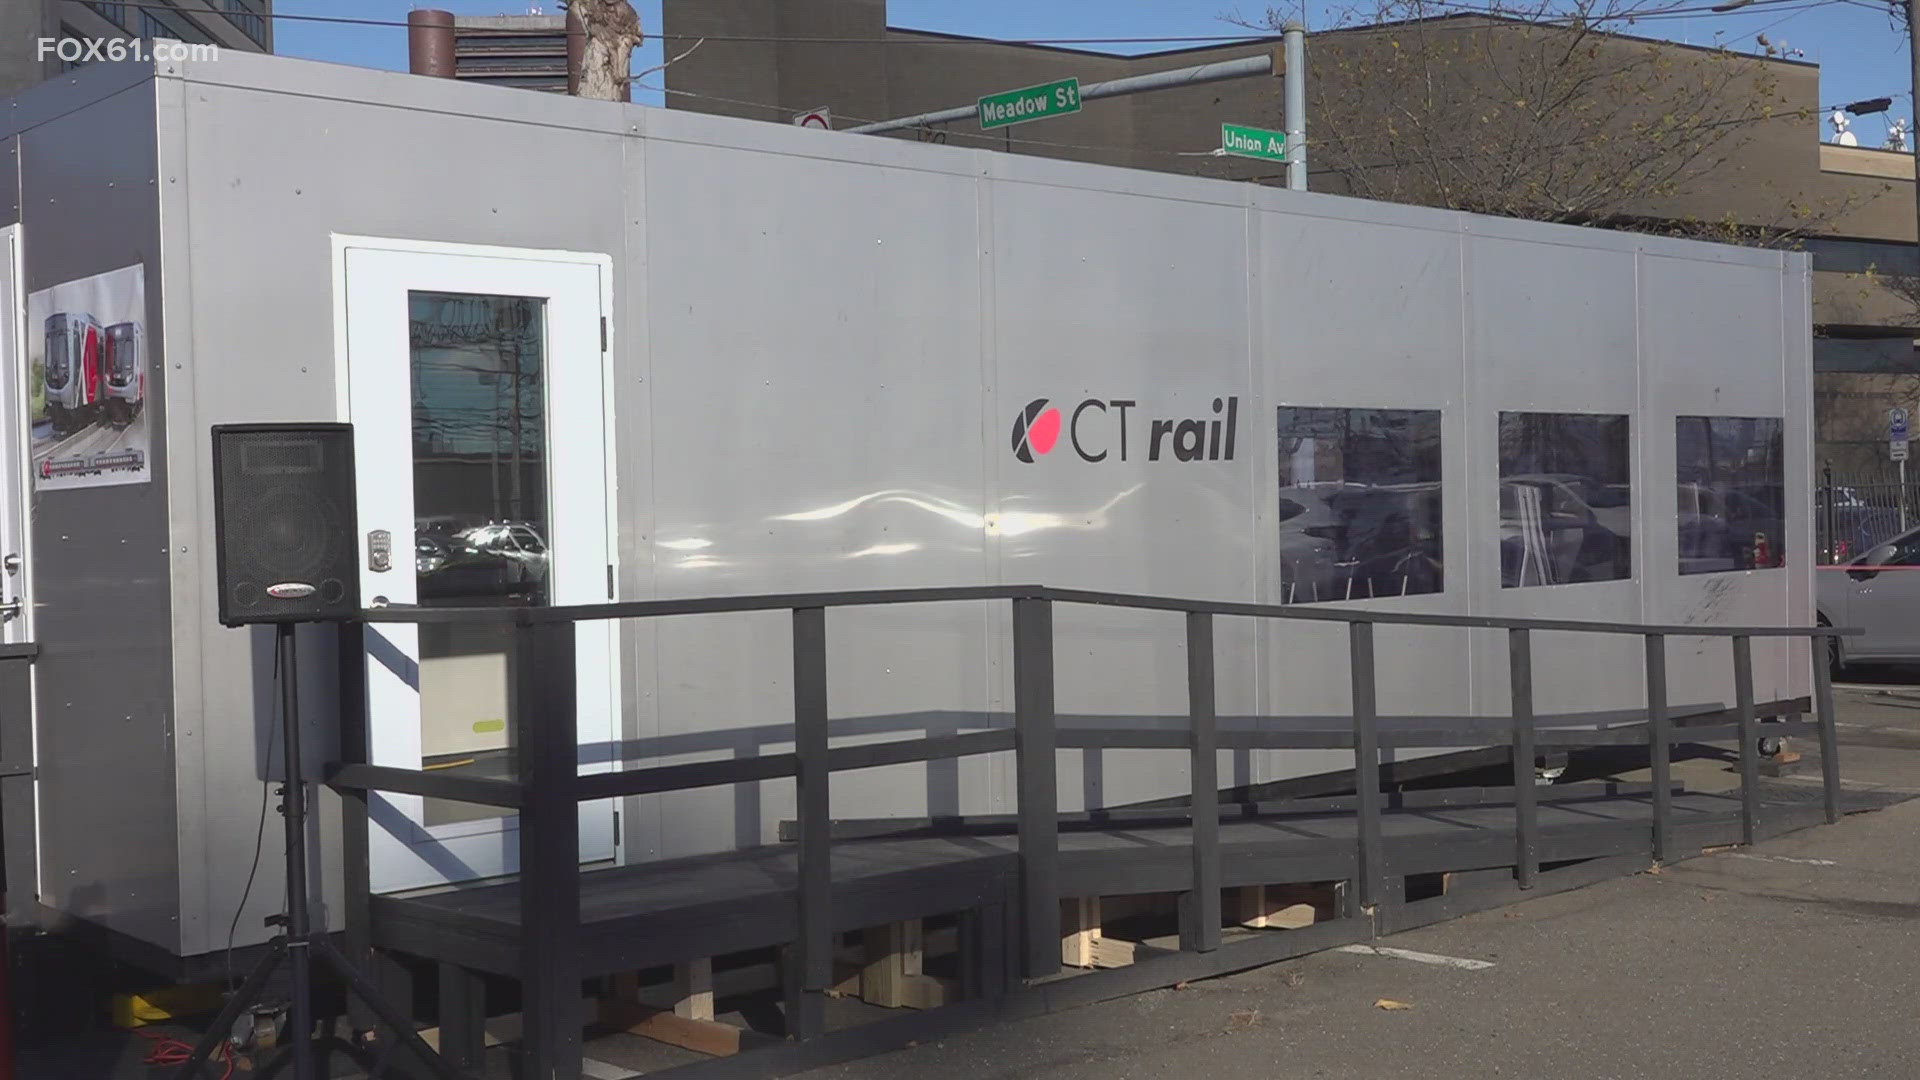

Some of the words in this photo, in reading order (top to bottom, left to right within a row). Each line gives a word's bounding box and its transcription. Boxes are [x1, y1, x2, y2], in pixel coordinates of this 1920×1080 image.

[983, 95, 1048, 122] Meadow
[1055, 86, 1076, 108] St
[1225, 130, 1262, 152] Union
[1267, 137, 1284, 154] Av
[1070, 398, 1136, 463] CT
[1148, 396, 1238, 463] rail
